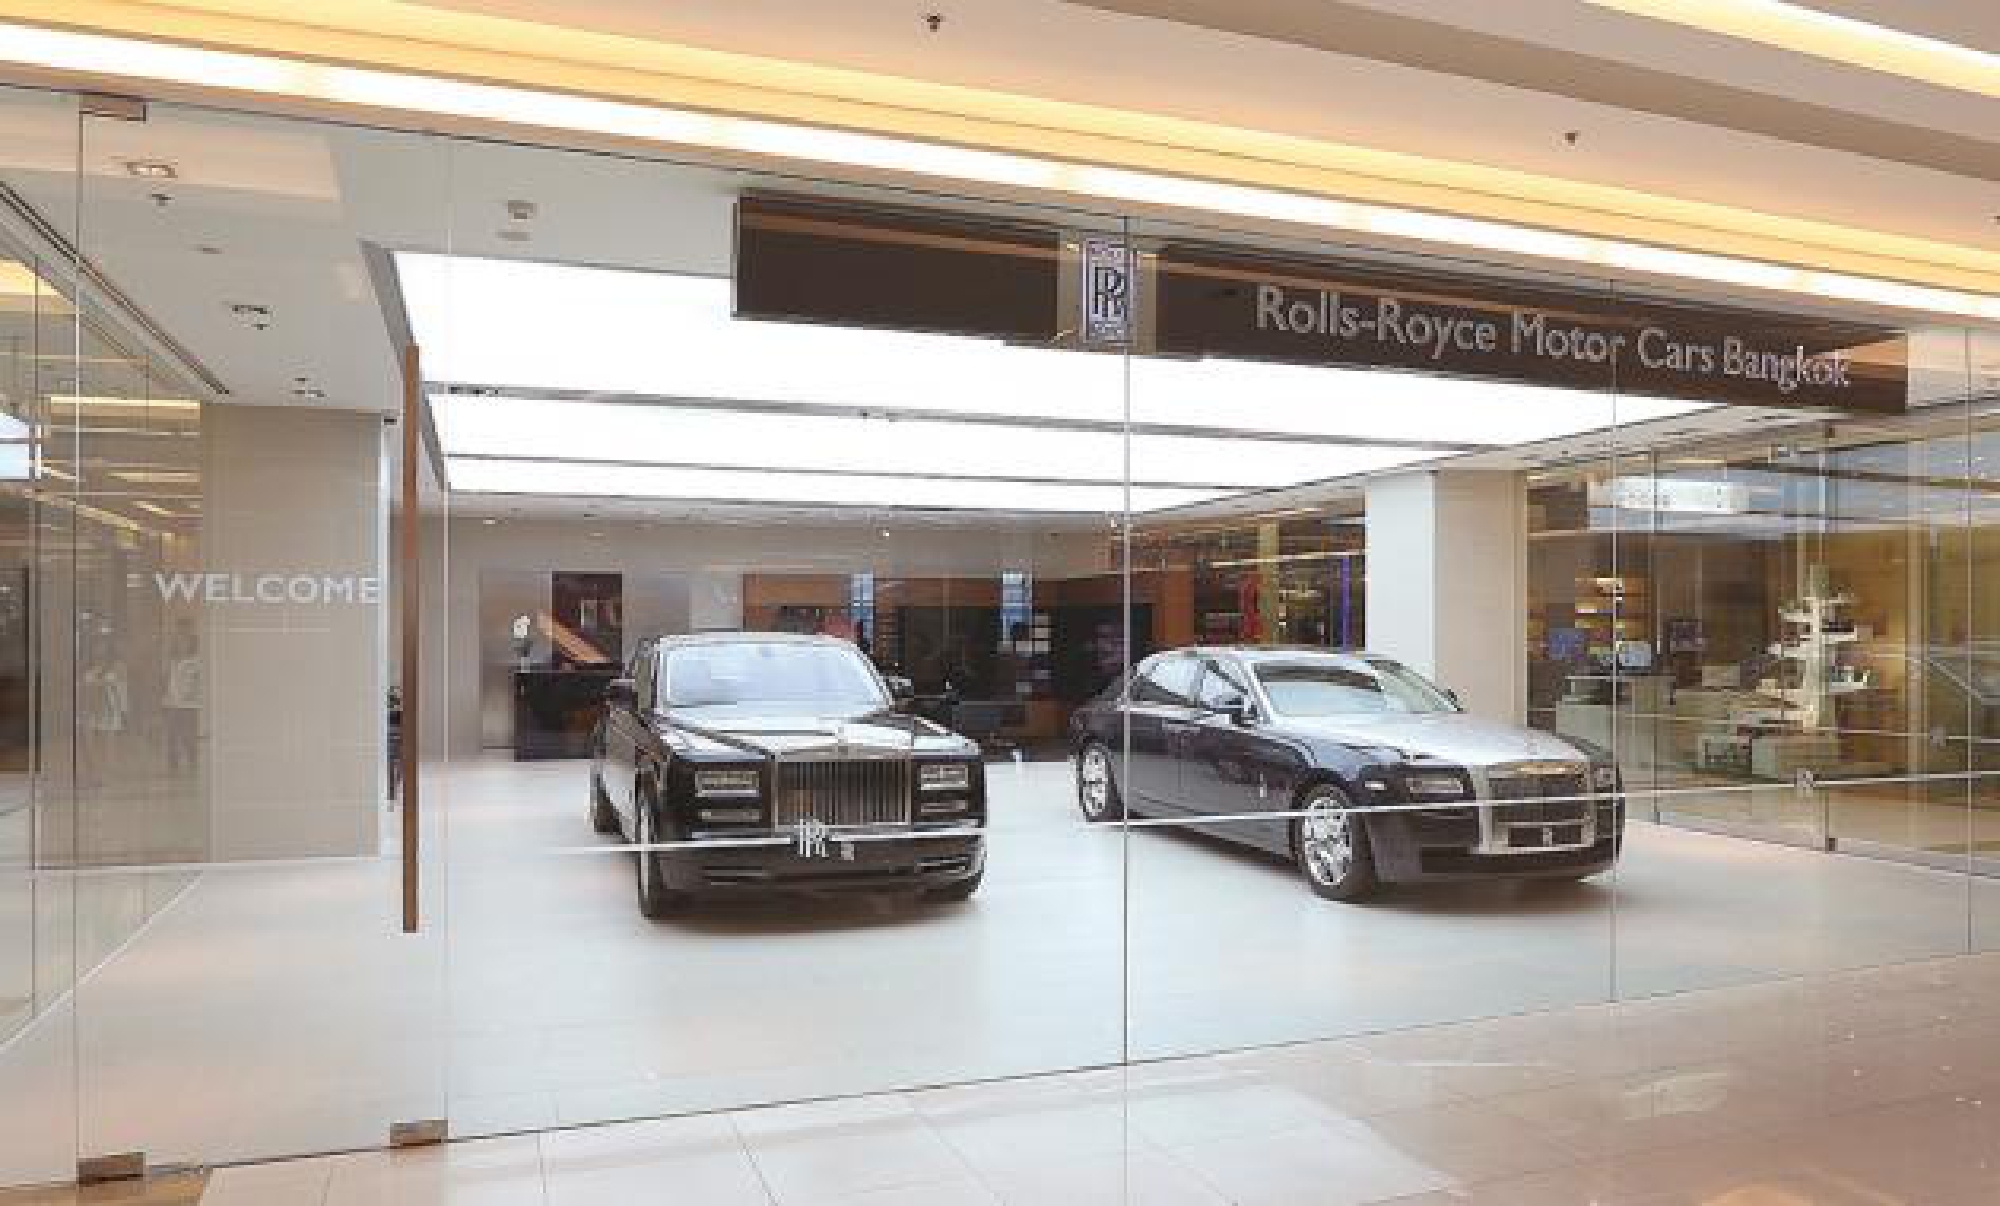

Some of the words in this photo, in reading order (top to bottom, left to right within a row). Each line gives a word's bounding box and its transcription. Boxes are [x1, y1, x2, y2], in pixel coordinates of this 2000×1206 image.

[1256, 285, 1496, 360] Rolls-Royce
[1511, 307, 1626, 363] Motor
[1638, 327, 1715, 373] Cars
[1723, 336, 1850, 394] Bangkok
[155, 573, 383, 604] WELCOME
